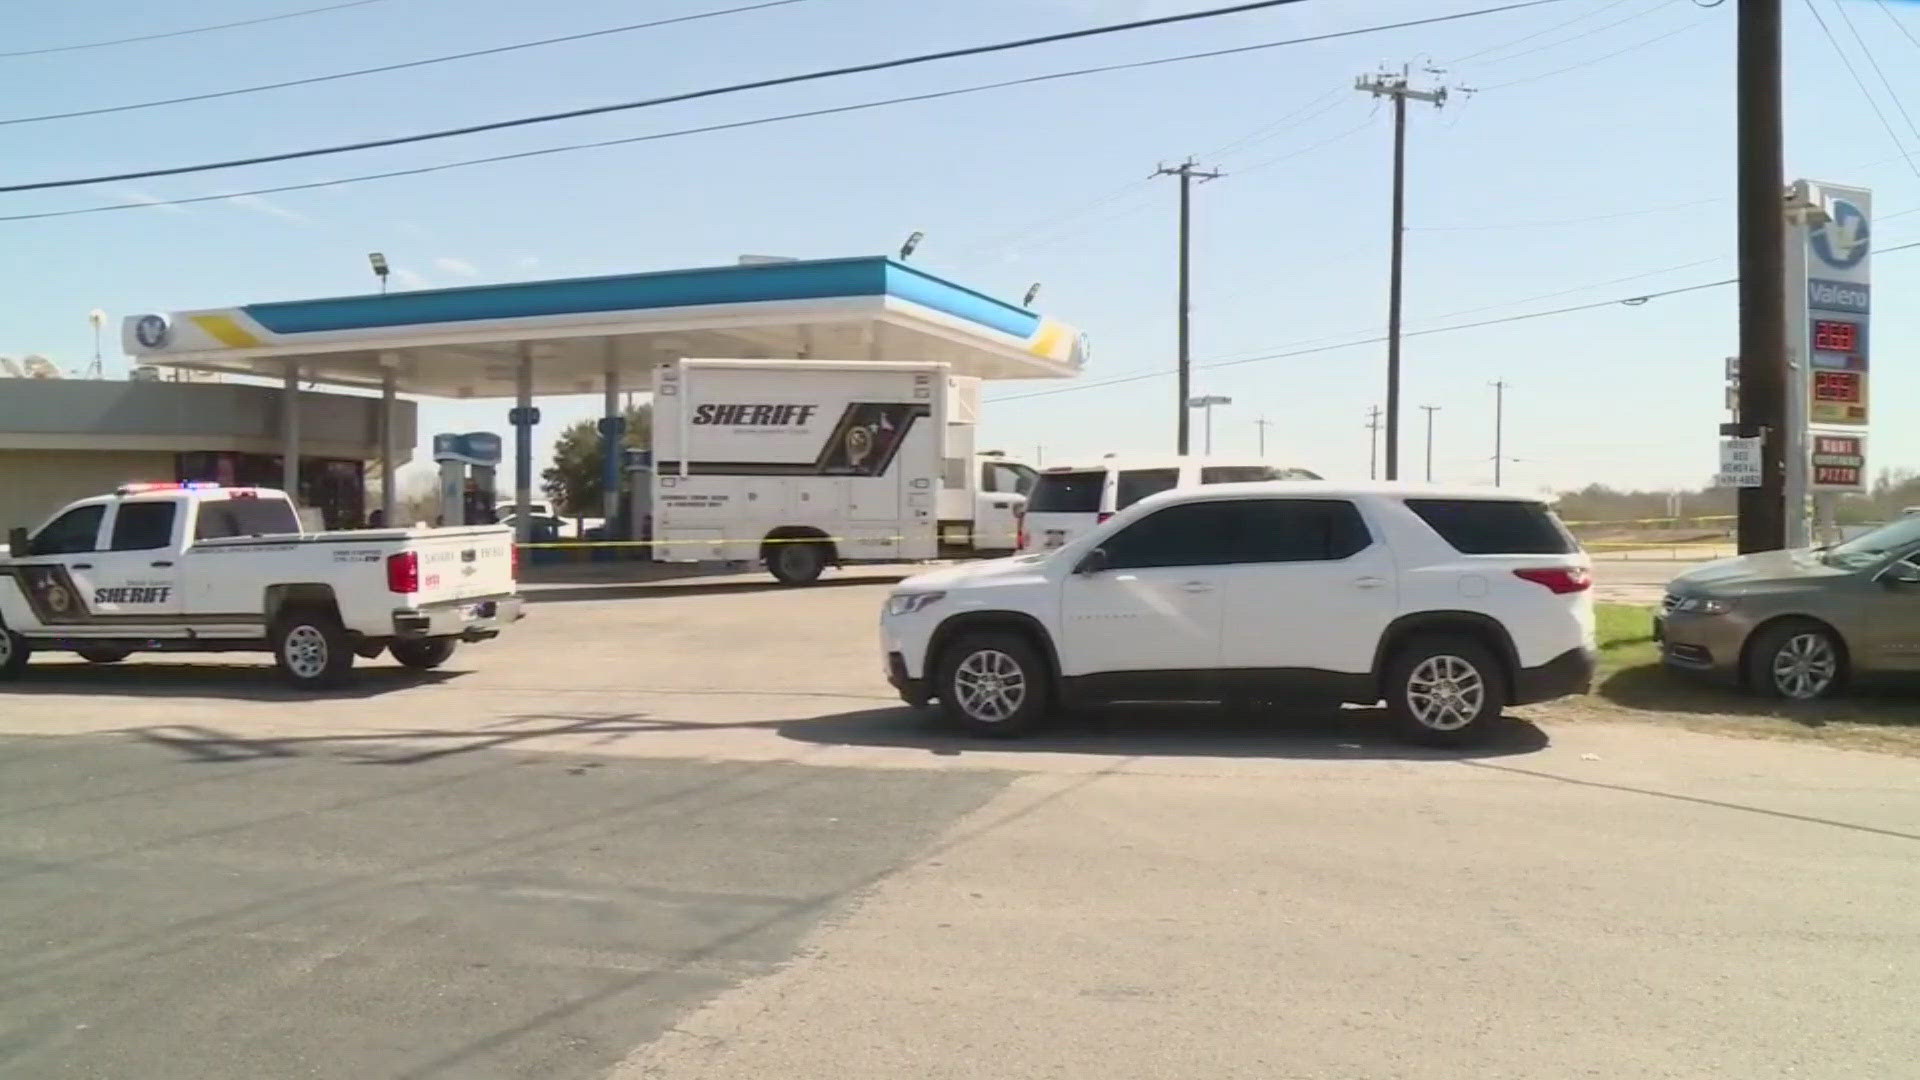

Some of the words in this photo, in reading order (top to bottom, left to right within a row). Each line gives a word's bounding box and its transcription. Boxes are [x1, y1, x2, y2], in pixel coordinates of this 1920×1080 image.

[1809, 282, 1867, 307] Valero
[692, 404, 819, 426] SHERIFF
[94, 586, 173, 604] SHERIFF
